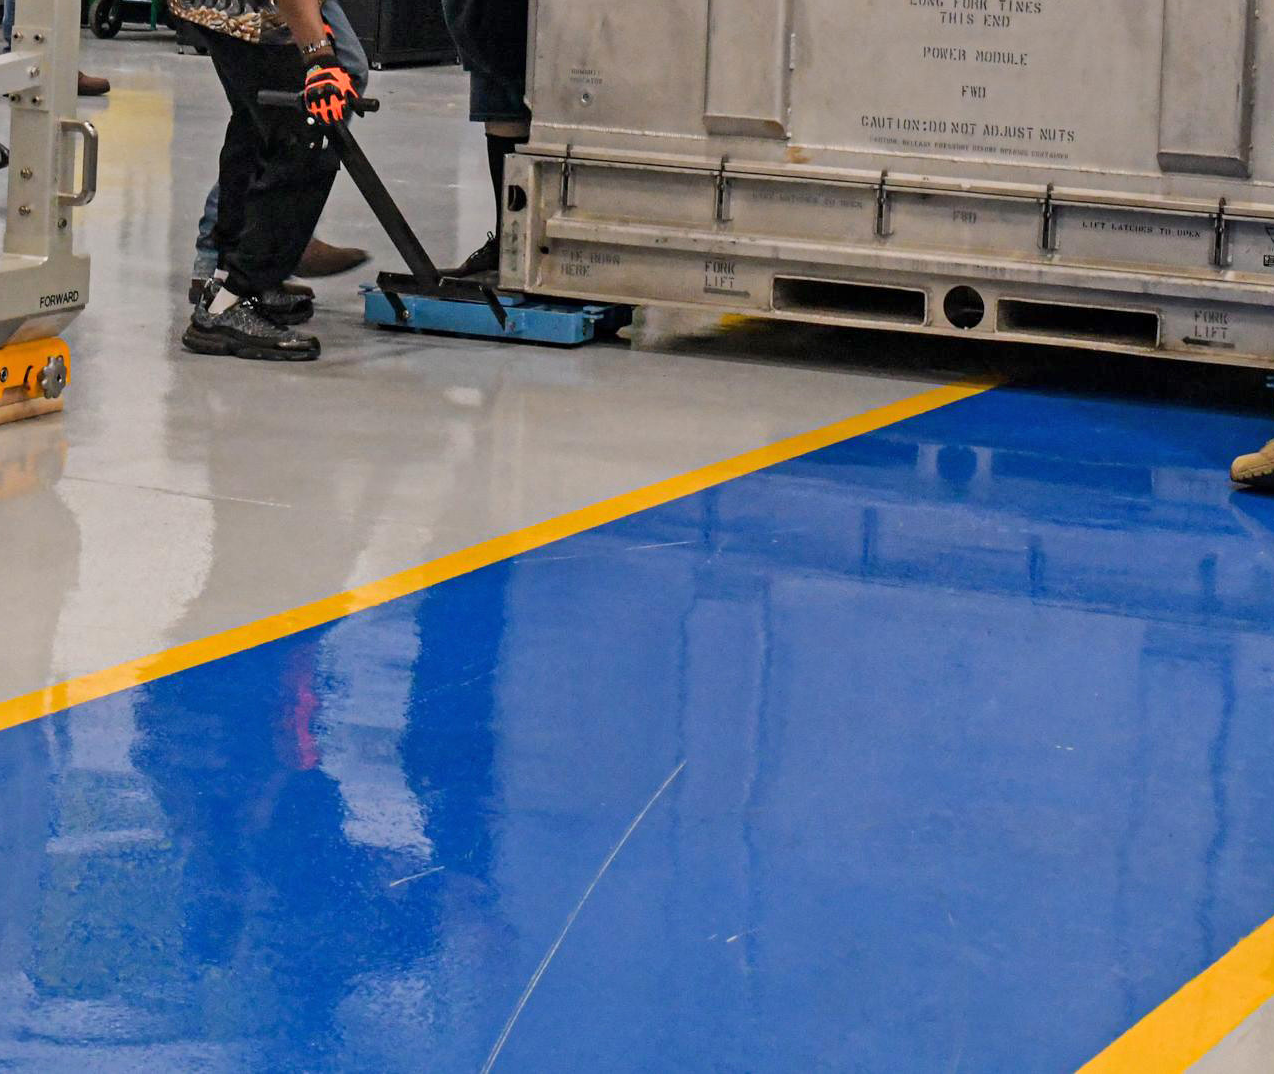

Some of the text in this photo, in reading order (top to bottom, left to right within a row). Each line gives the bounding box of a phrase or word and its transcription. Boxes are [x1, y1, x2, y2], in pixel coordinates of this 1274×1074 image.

[999, 0, 1042, 14] TINES
[940, 11, 1010, 28] THIS END
[923, 46, 1028, 66] POWER MODULE
[961, 85, 986, 98] FWD
[950, 121, 977, 136] NOT
[982, 124, 1034, 140] ADJUST
[1039, 127, 1076, 142] NUTS
[1082, 221, 1200, 238] LIFT LATCHES TO OPEN
[705, 260, 735, 275] FORK
[705, 275, 734, 288] LIFT
[39, 290, 79, 309] FORWARD
[1194, 309, 1228, 324] FORK
[1194, 325, 1228, 339] LIFT
